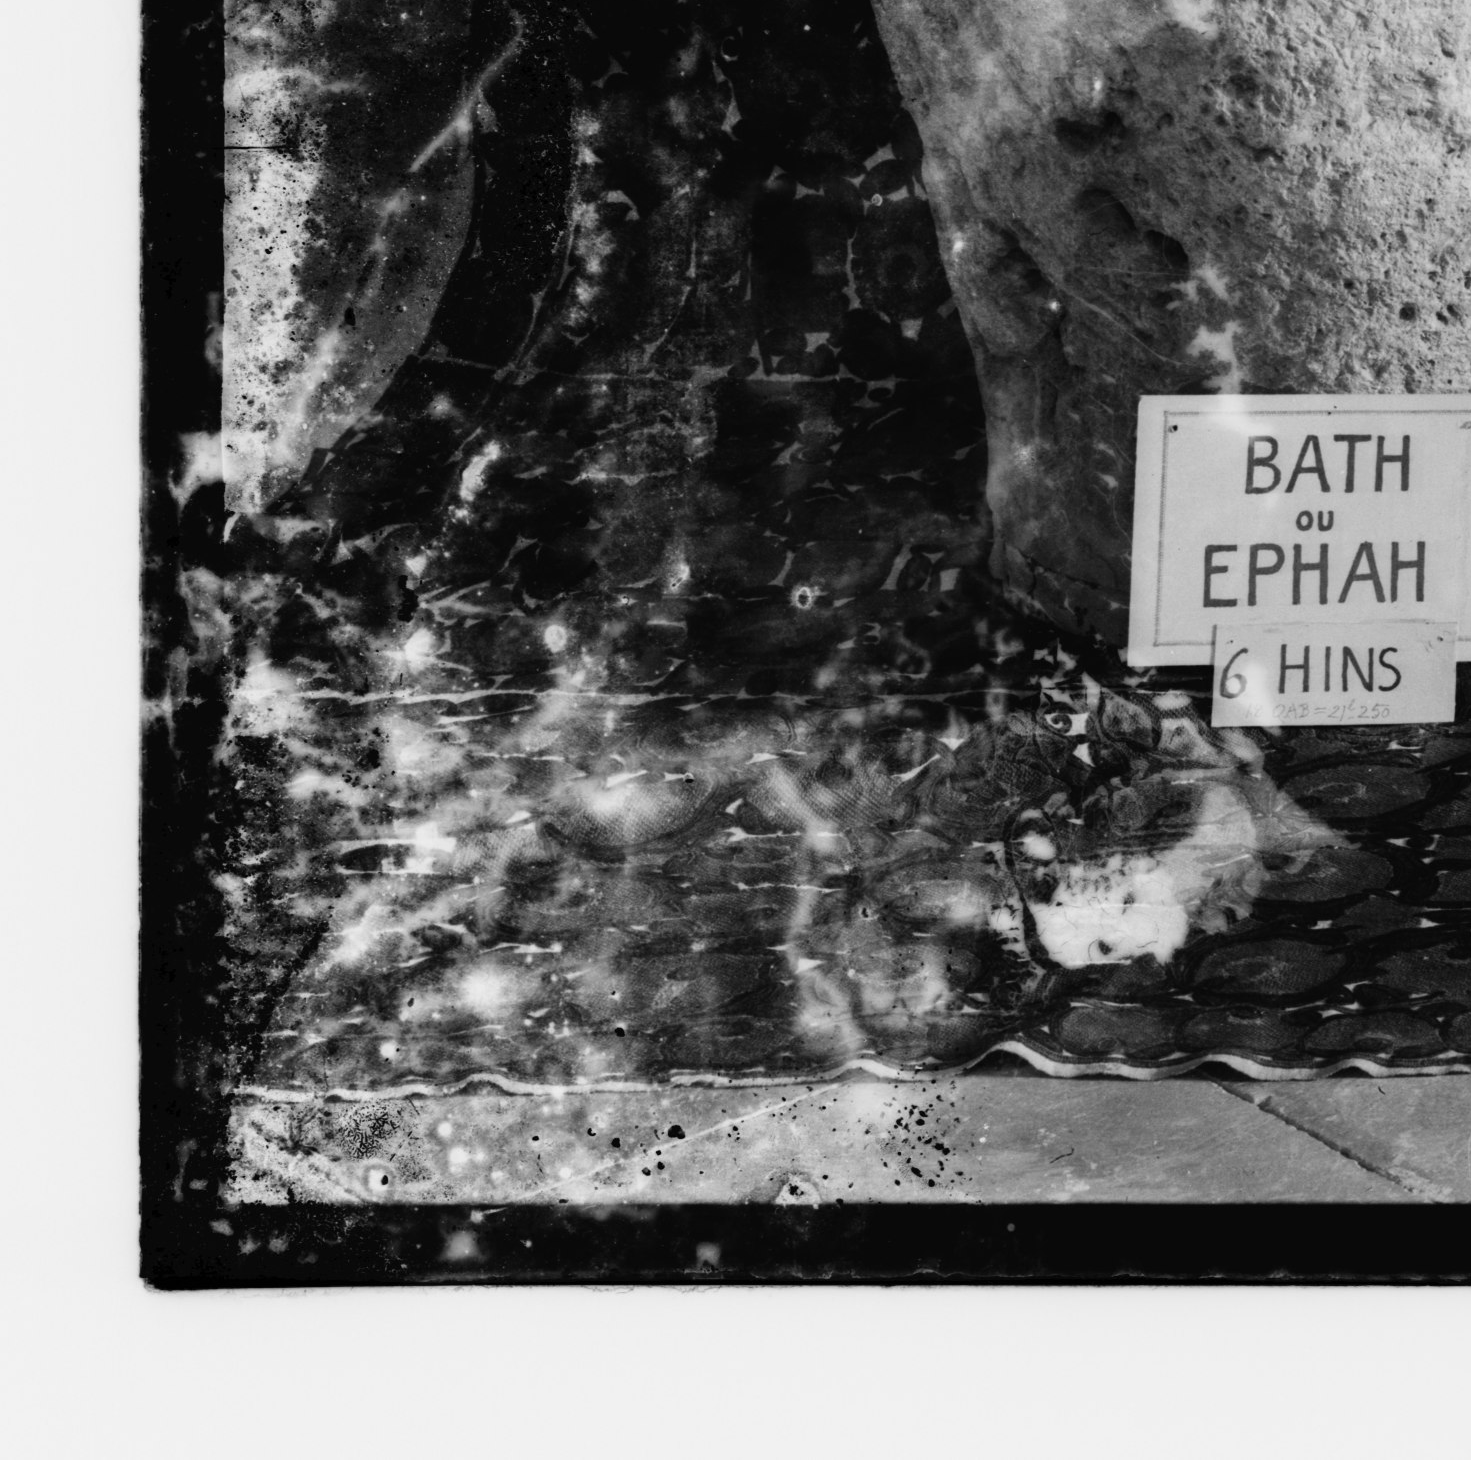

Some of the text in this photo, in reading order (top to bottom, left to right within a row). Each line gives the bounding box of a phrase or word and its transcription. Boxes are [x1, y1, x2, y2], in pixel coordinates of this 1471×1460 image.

[1245, 434, 1410, 494] BATH
[1203, 541, 1425, 608] EPHAH
[1219, 644, 1401, 699] 6 HINS
